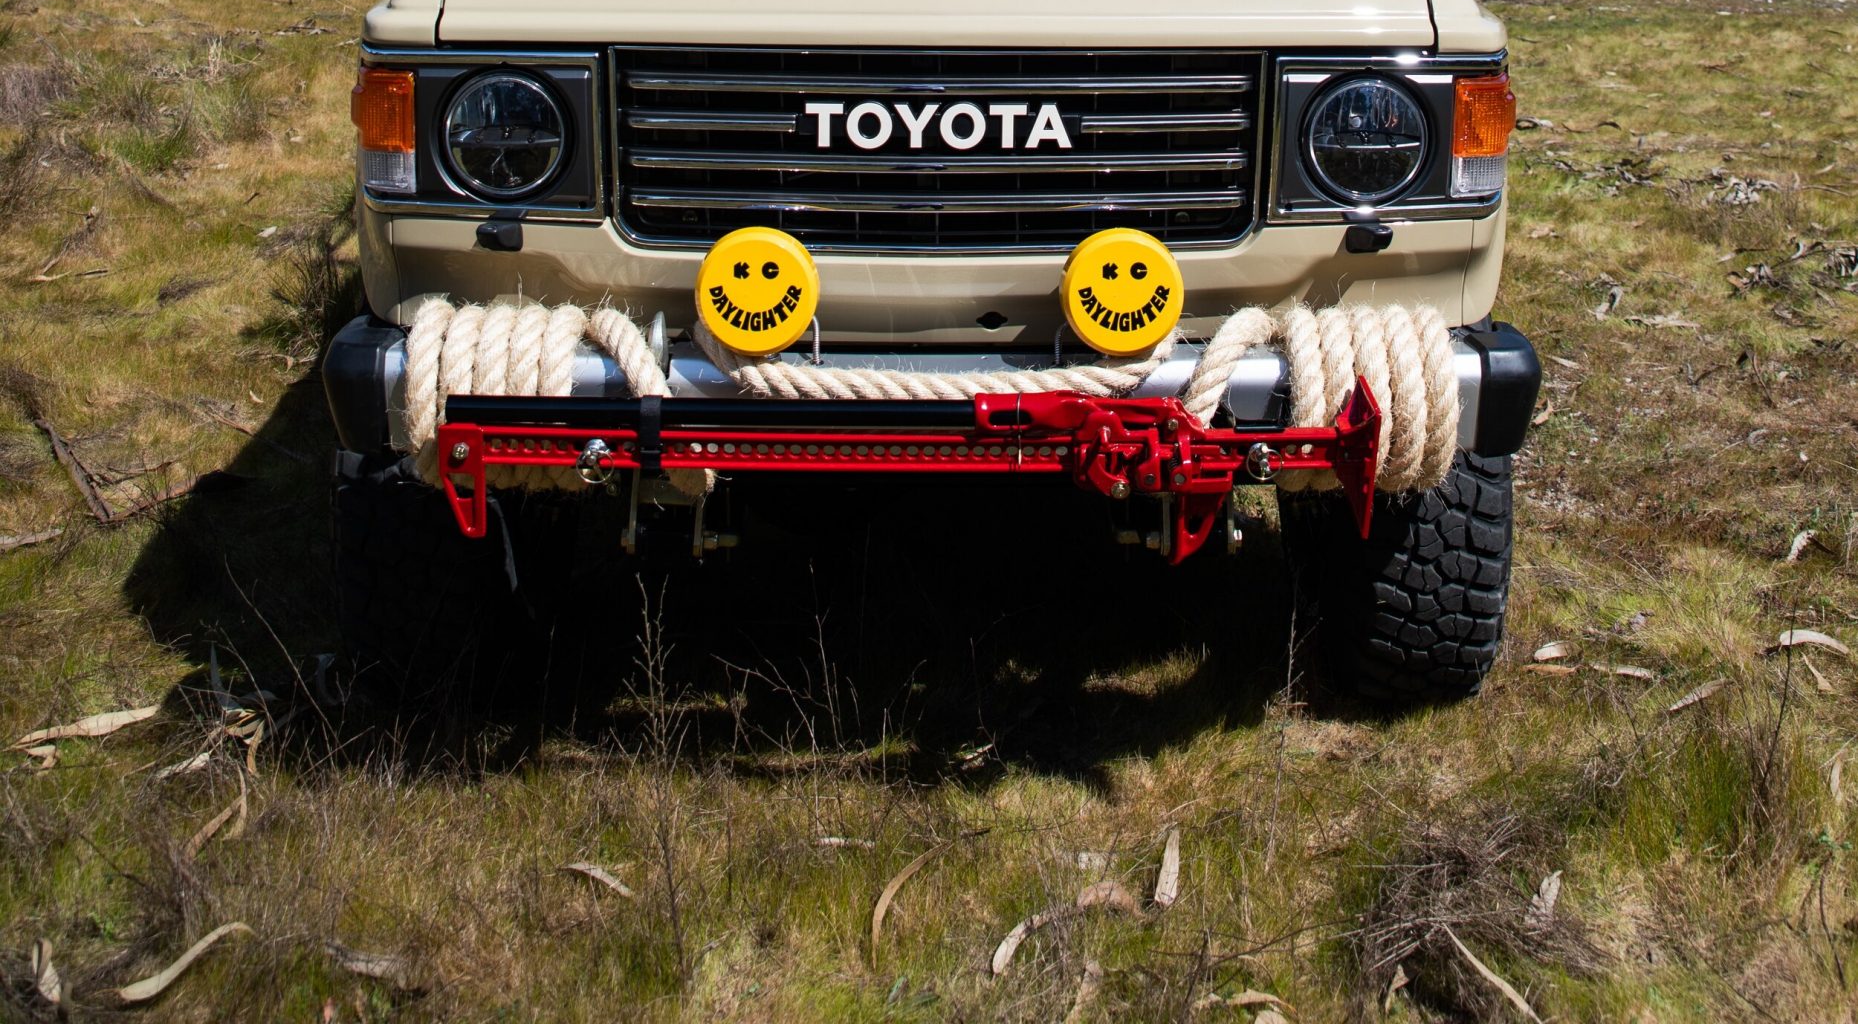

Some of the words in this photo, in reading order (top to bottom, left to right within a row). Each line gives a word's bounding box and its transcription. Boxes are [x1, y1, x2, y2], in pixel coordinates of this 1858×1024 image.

[805, 102, 1072, 150] TOYOTA
[709, 285, 802, 332] DAYLIGHTER
[1078, 285, 1170, 332] DAYLIGHTER
